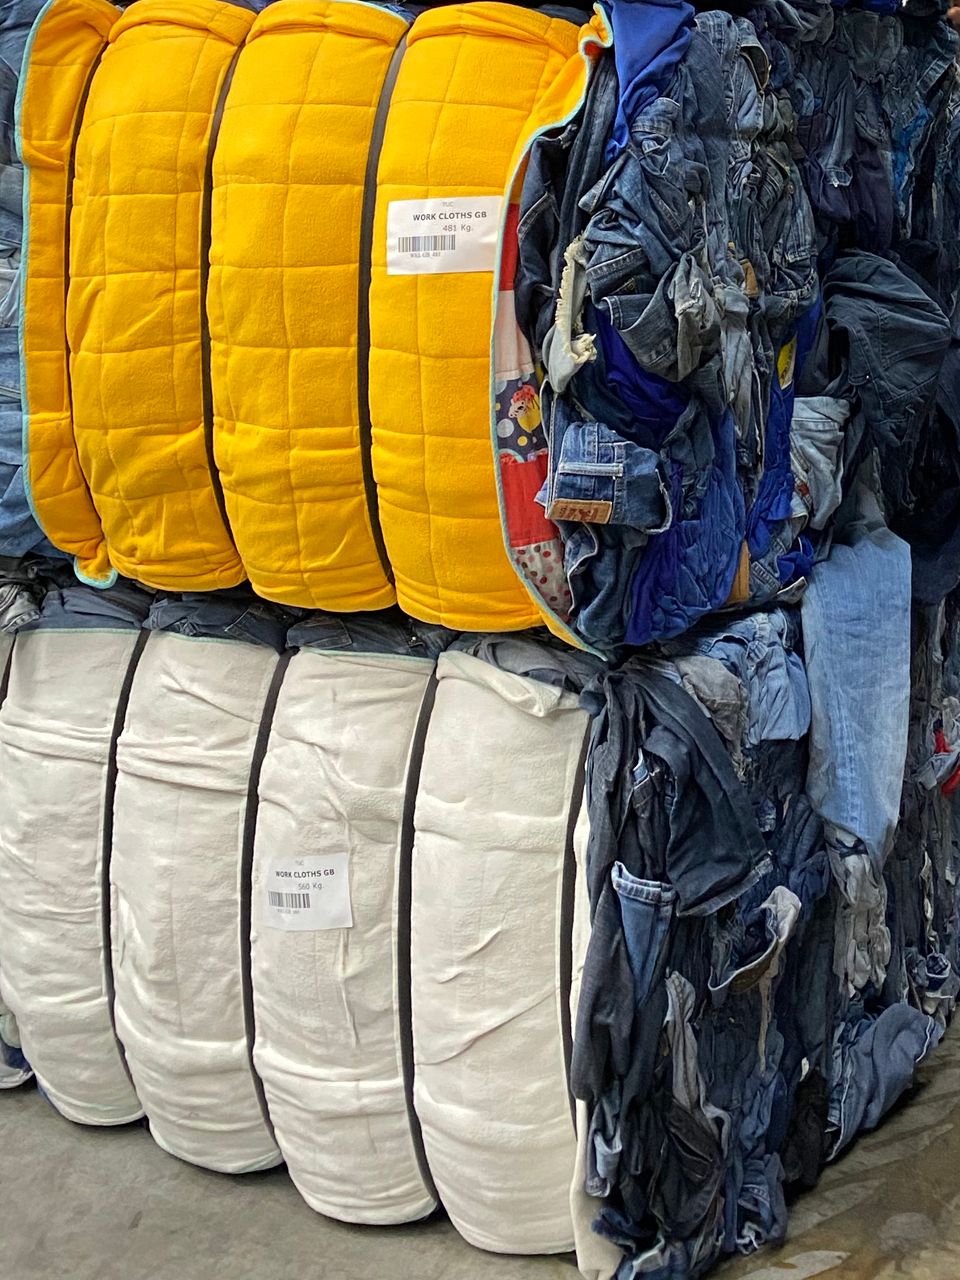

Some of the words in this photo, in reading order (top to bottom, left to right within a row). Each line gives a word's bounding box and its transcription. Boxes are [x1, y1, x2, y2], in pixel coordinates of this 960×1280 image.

[412, 213, 437, 222] WORK
[438, 211, 473, 221] CLOTHS
[474, 210, 487, 219] GB
[442, 224, 457, 232] 481
[275, 870, 293, 879] WORK
[293, 870, 322, 879] CLOTHS
[323, 868, 335, 876] GB
